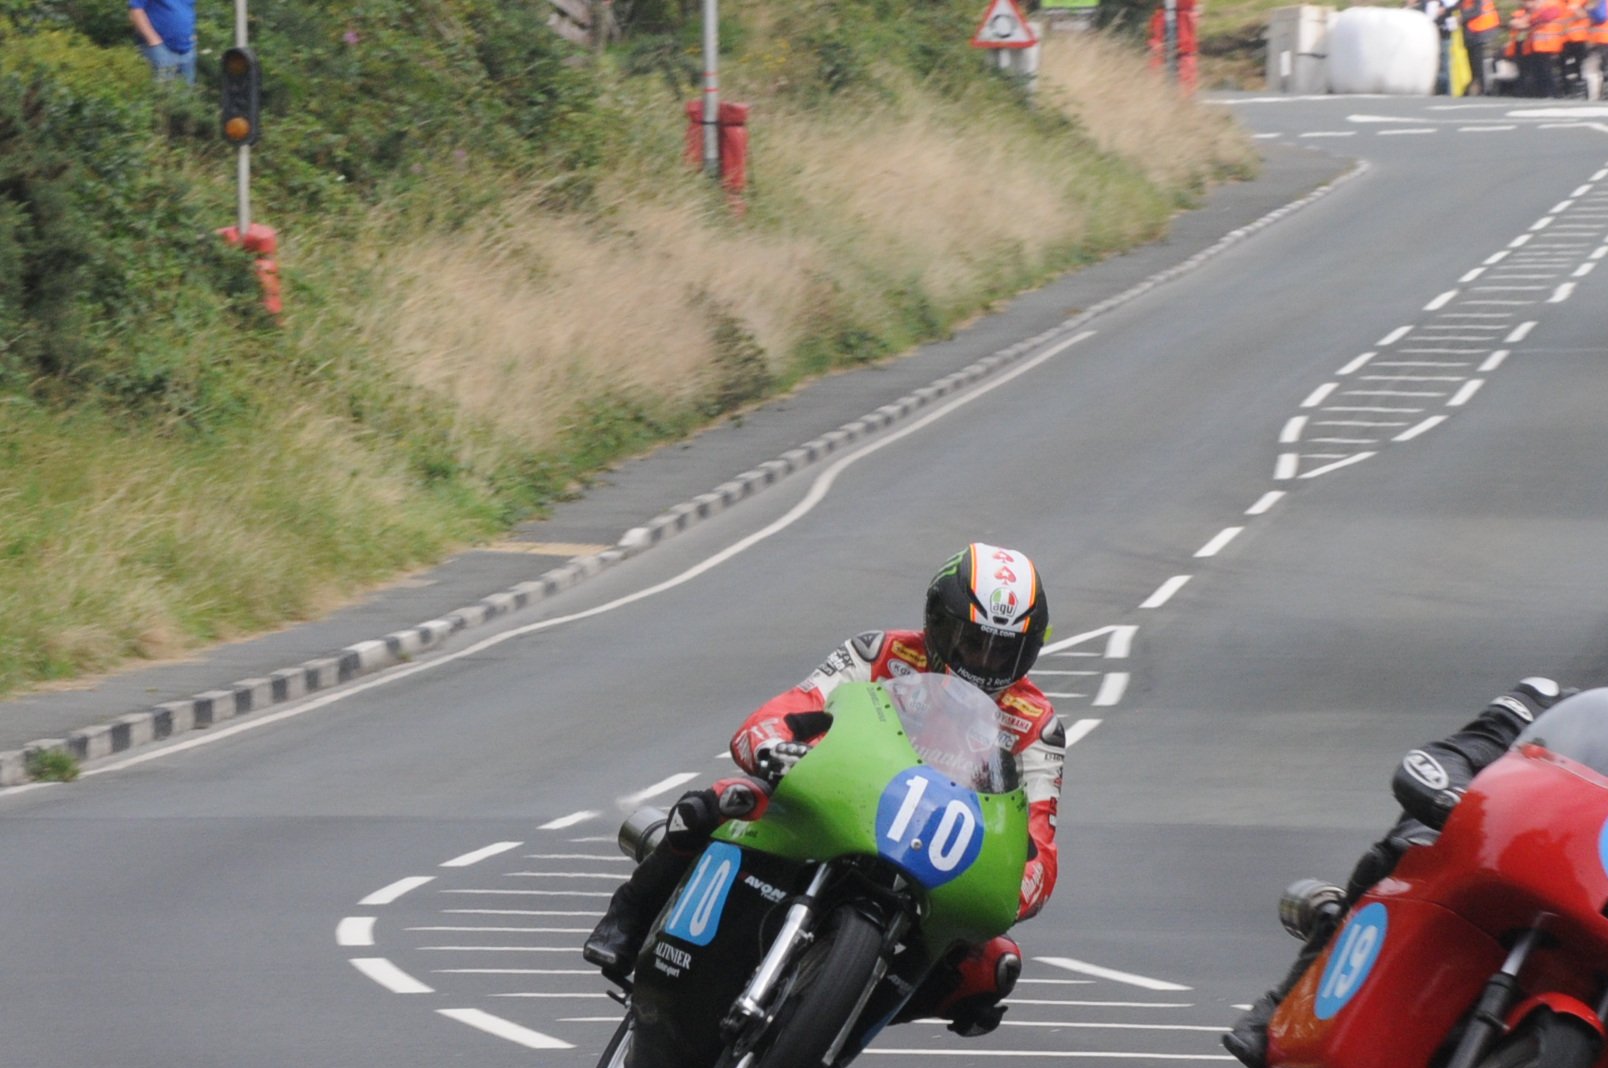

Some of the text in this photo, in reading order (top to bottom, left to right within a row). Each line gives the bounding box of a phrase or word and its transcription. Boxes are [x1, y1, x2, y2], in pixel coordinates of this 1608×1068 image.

[886, 775, 976, 872] 10
[668, 854, 731, 937] 10
[744, 875, 787, 901] AVON
[1321, 923, 1378, 999] 19
